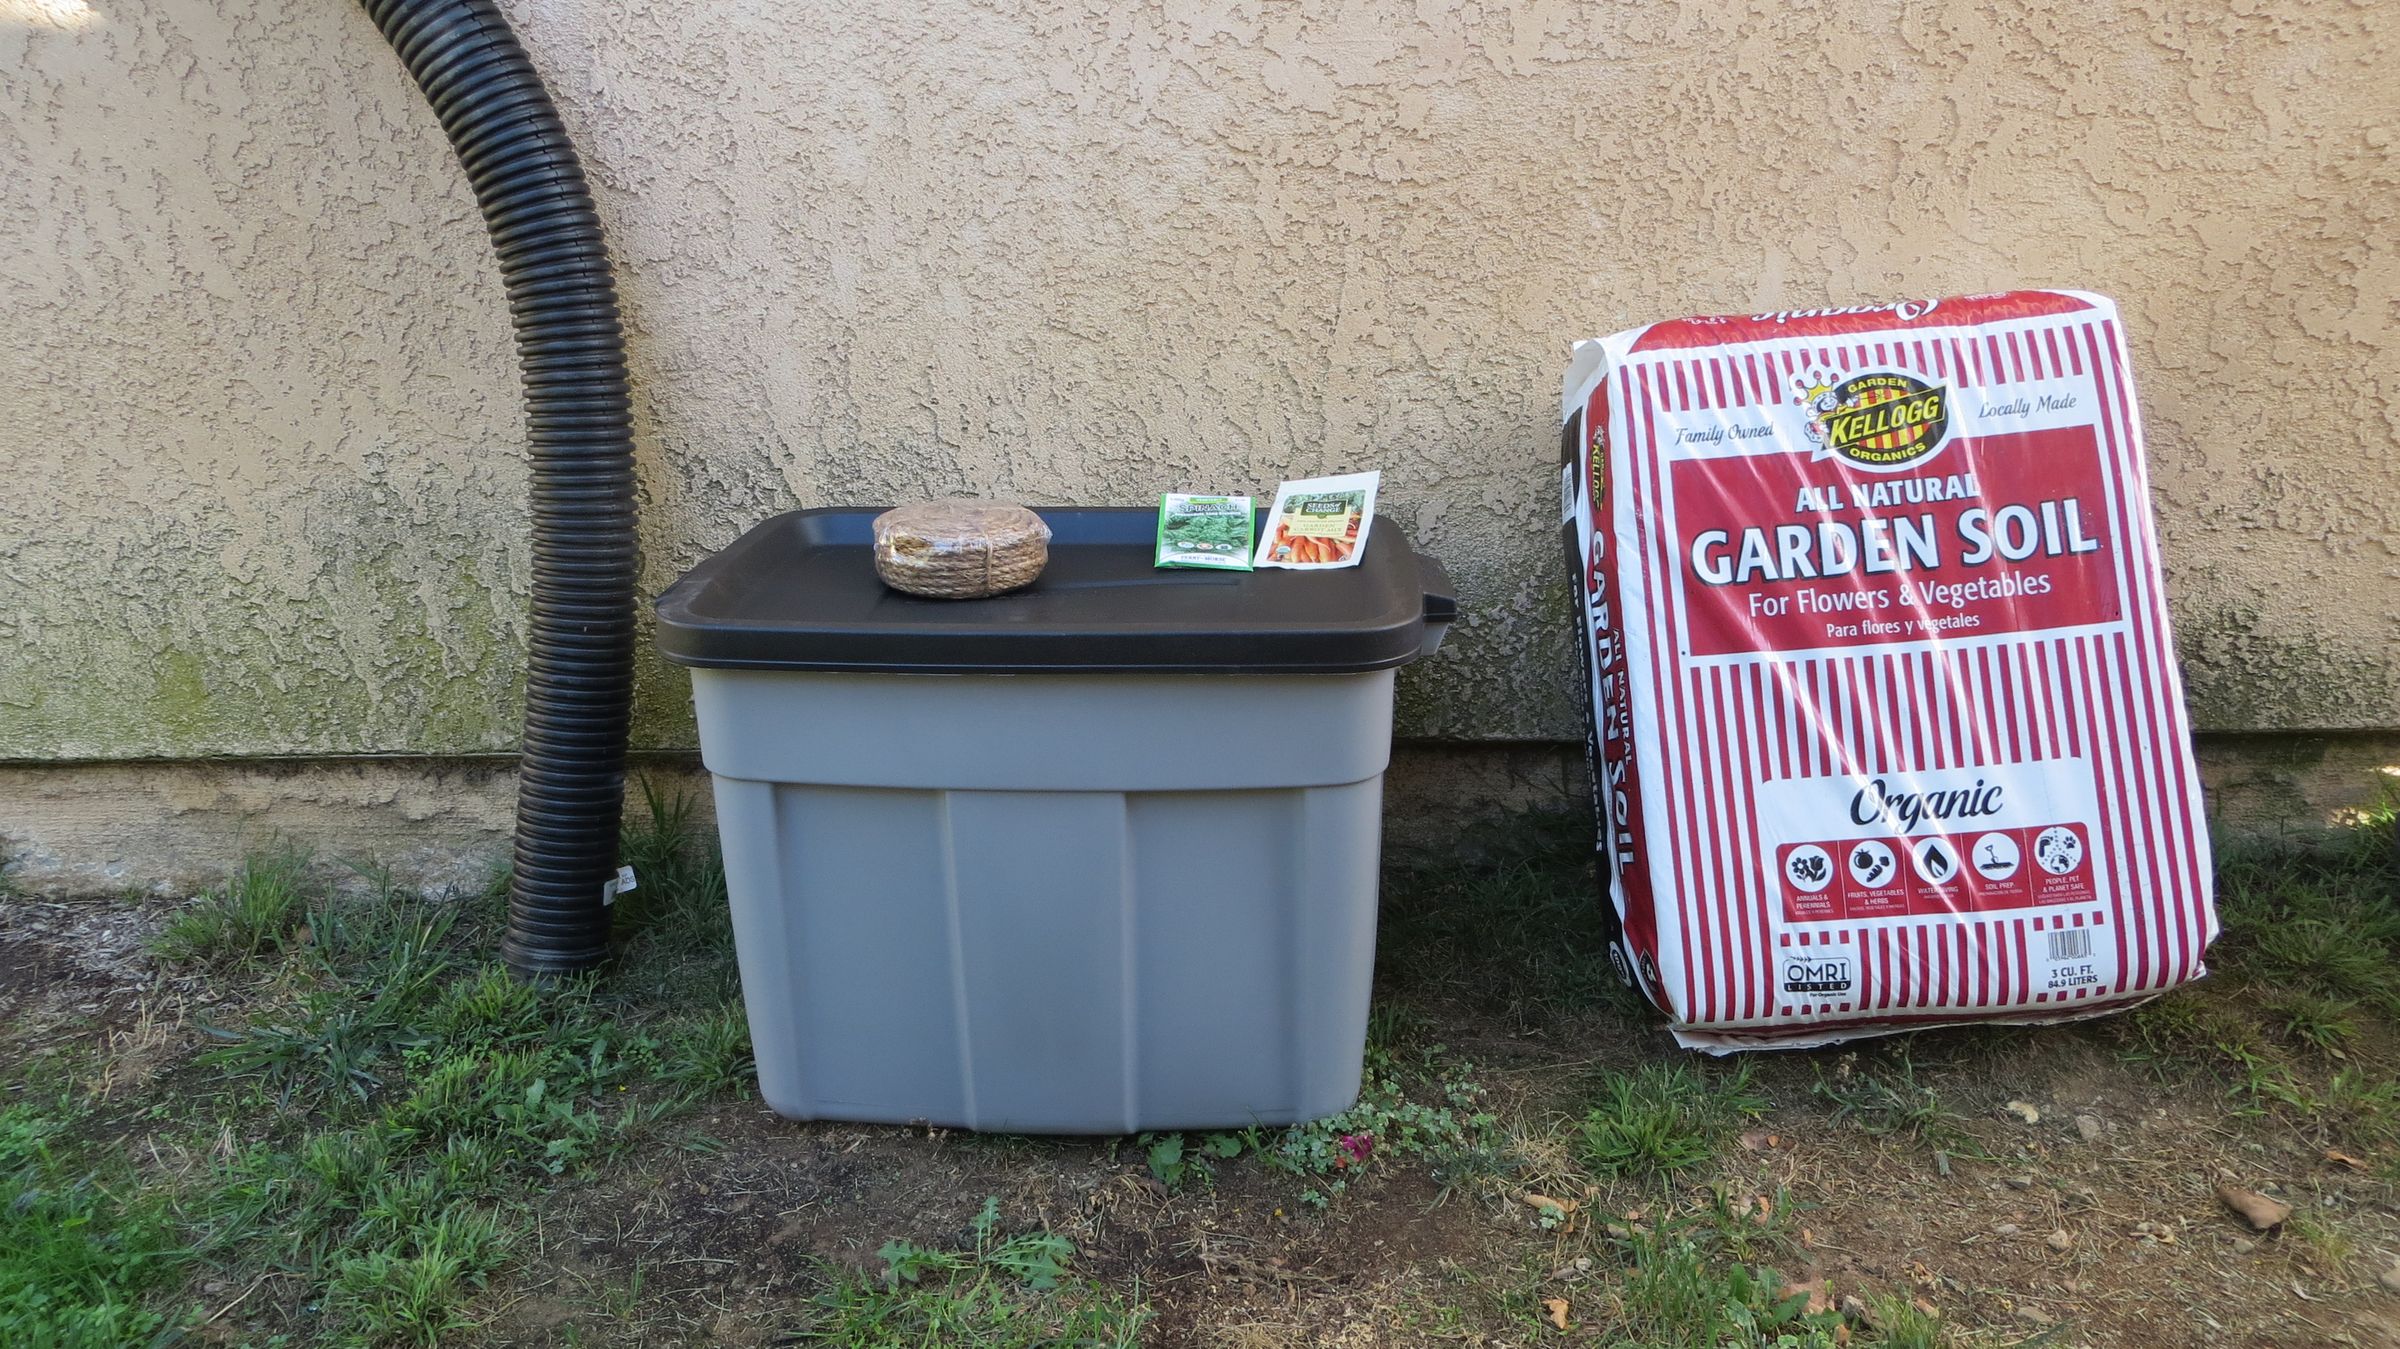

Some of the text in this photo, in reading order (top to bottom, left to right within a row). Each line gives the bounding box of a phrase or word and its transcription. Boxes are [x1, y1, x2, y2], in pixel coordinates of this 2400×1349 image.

[1847, 377, 1908, 395] GARDEN
[1978, 393, 2078, 419] Locally Made
[1828, 394, 1940, 447] KELLOGG
[1674, 421, 1775, 447] Family Owned
[1848, 441, 1928, 463] ORGANICS
[1794, 472, 1982, 514] ALL NATURAL
[1689, 497, 2100, 586] GARDEN SOIL
[1749, 570, 2052, 618] For Flowers & Vegetables
[1826, 613, 1981, 639] Para flores y vegetales
[1591, 530, 1635, 876] GARDEN SOIL
[1617, 670, 1633, 767] NATURAL
[1849, 778, 2004, 835] Organic
[1984, 882, 1998, 890] SOIL
[1787, 962, 1848, 982] OMRI
[2047, 974, 2098, 989] 84.9 LITERS
[2051, 964, 2094, 979] 3 CU. FT.
[1787, 982, 1848, 991] LISTED
